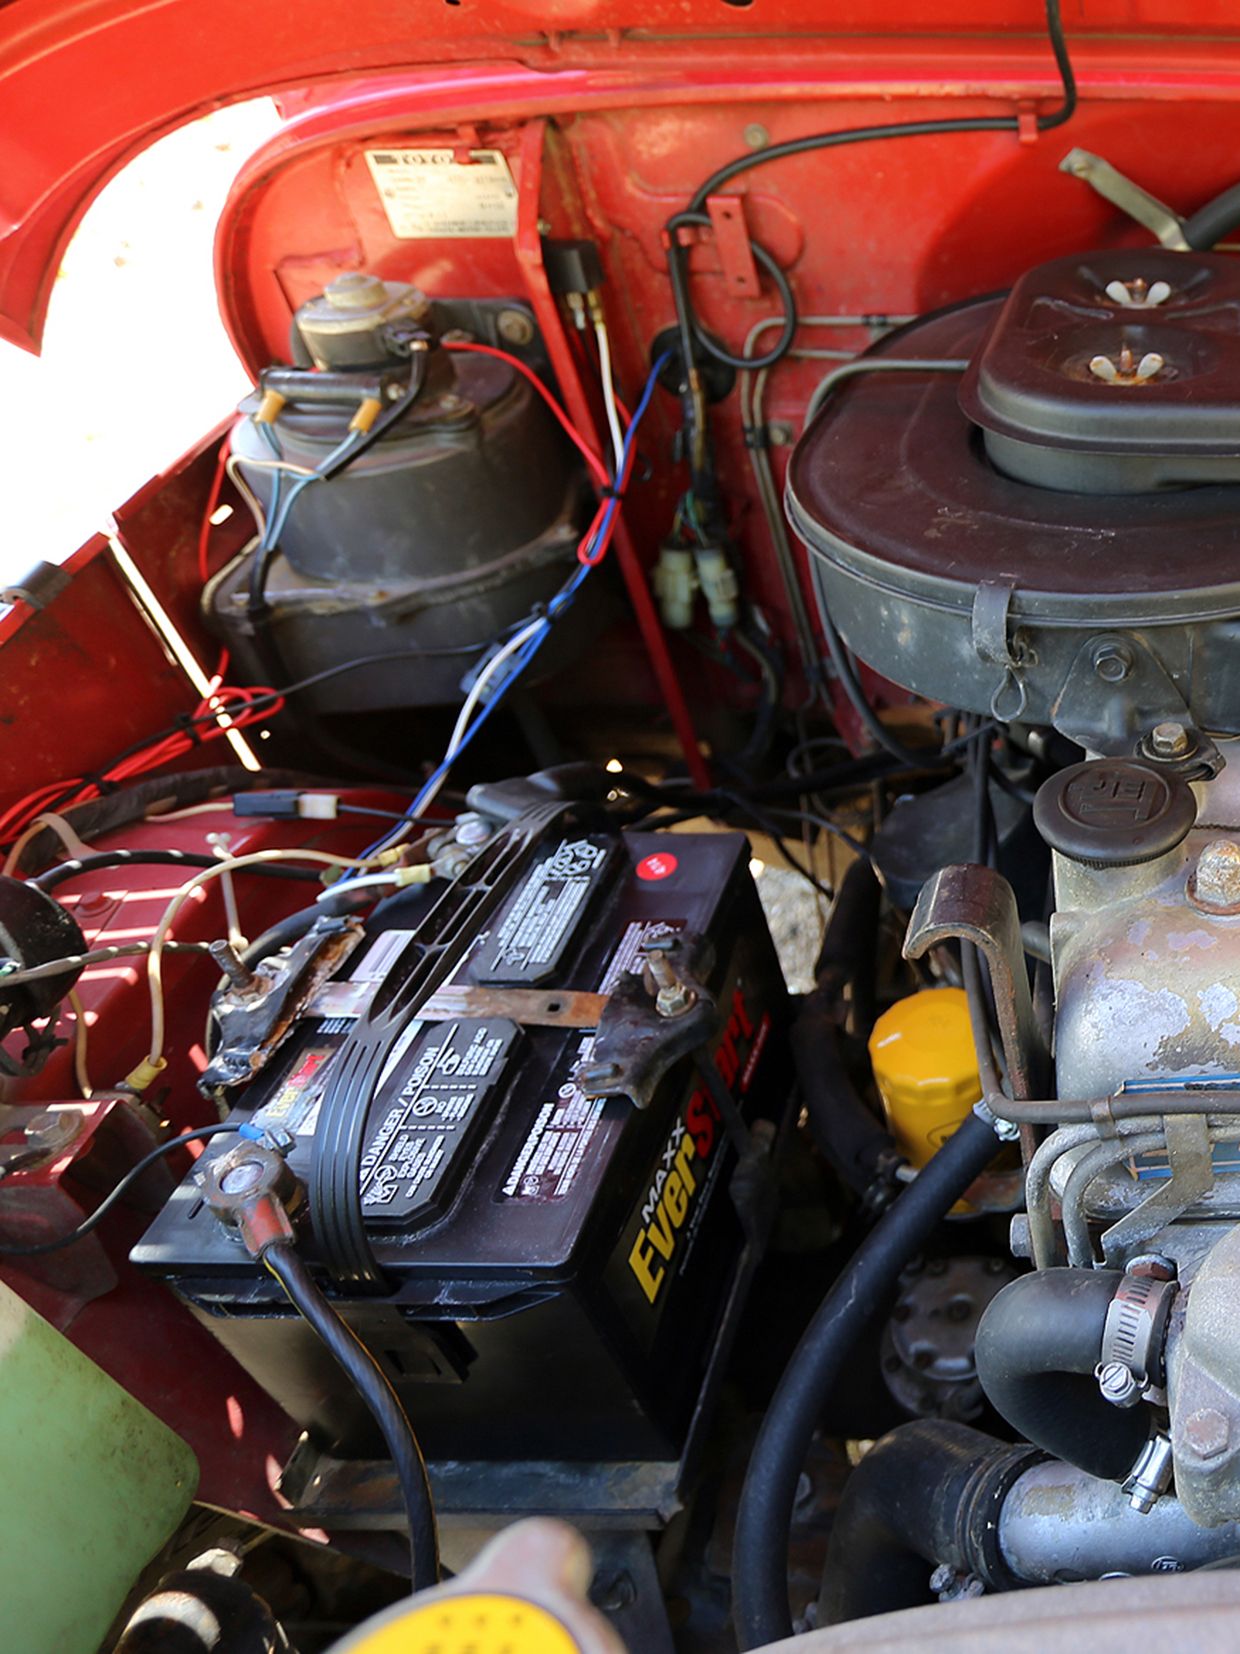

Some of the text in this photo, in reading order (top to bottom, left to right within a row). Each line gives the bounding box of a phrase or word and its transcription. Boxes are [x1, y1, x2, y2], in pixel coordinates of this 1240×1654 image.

[362, 1109, 404, 1165] DANGER
[402, 1047, 440, 1095] POISON
[641, 1116, 686, 1223] MAXX
